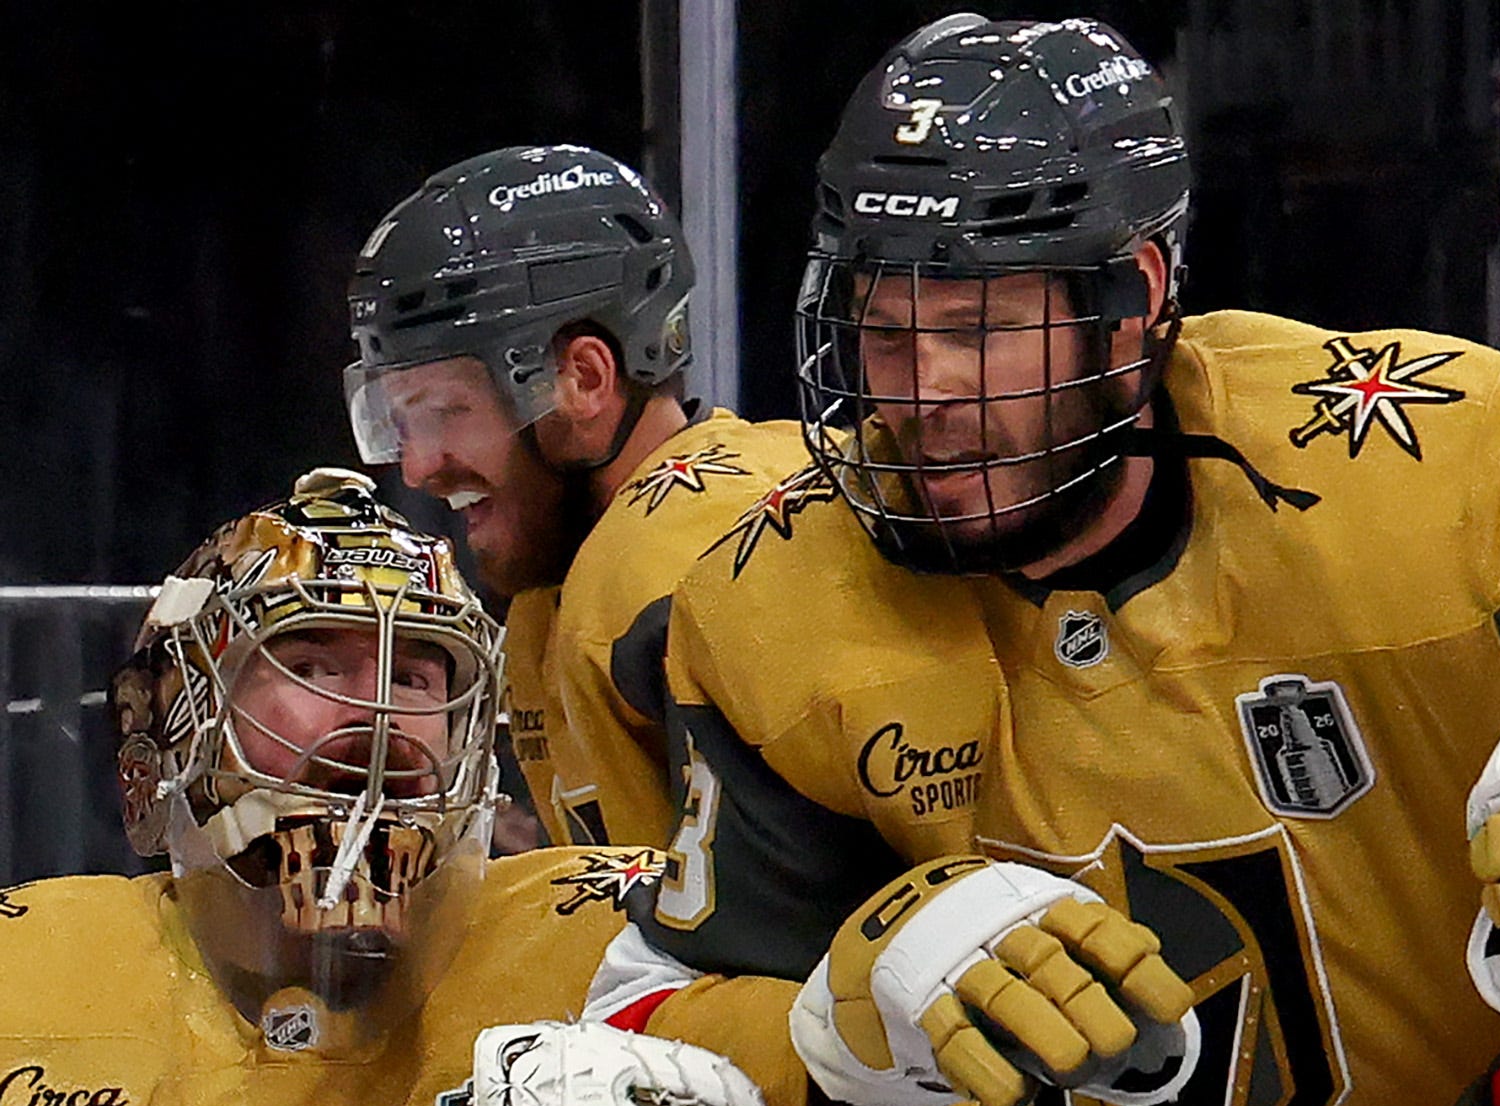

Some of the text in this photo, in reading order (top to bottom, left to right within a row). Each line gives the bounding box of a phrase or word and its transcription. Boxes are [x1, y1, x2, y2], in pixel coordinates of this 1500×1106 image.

[894, 100, 943, 144] 3
[854, 193, 959, 217] CCM
[858, 722, 984, 797] Circa
[861, 859, 987, 941] CC
